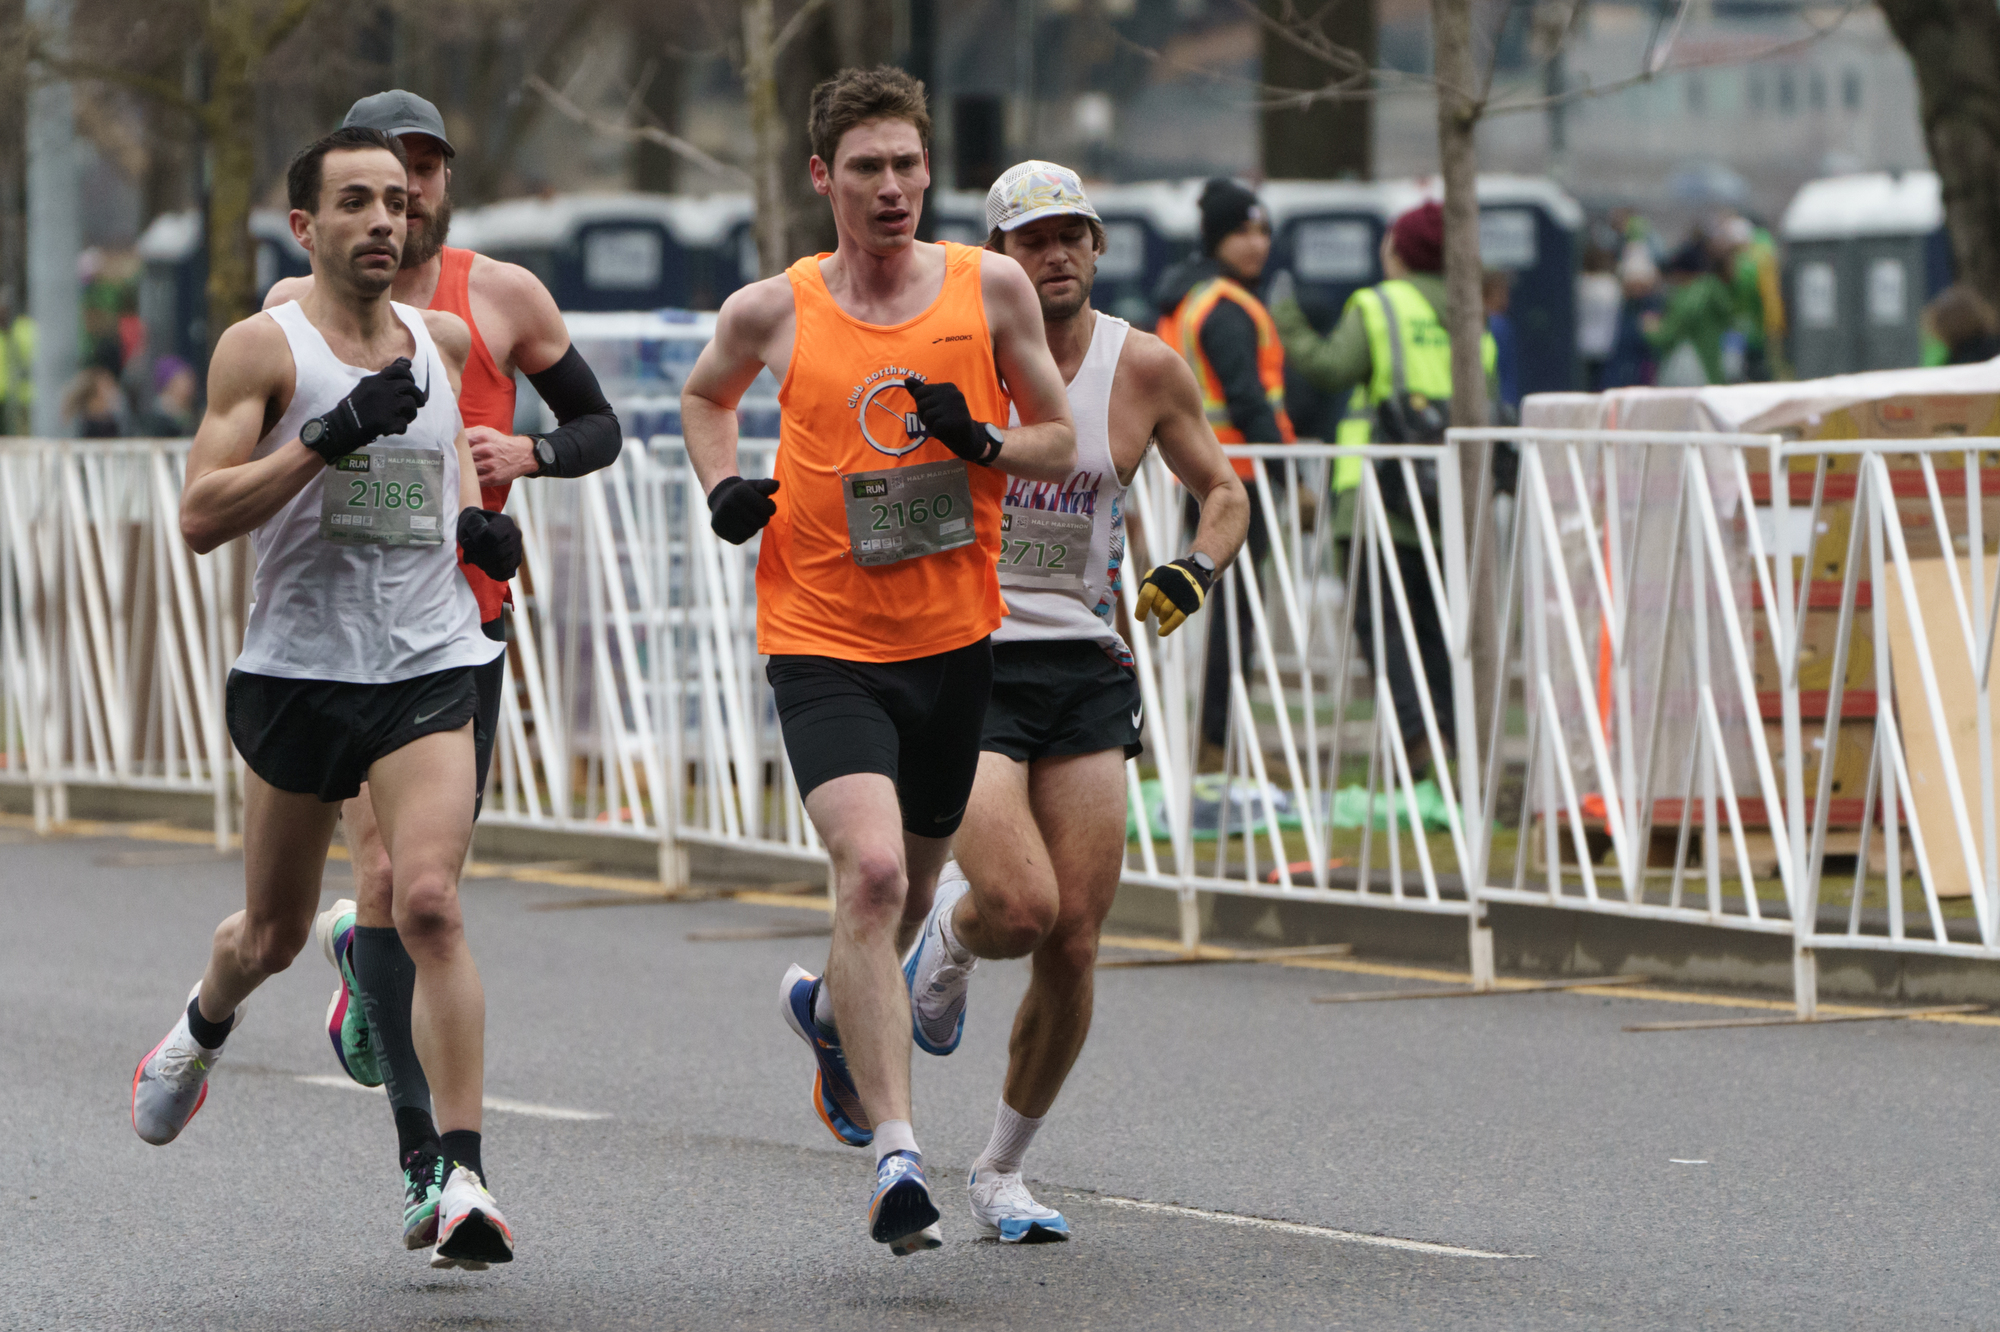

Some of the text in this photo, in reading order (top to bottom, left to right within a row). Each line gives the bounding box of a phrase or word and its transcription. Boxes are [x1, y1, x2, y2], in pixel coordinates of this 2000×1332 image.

[945, 334, 973, 343] BROOKS
[847, 365, 928, 409] club northwest
[349, 459, 368, 469] RUN
[405, 458, 440, 466] MARATHON
[907, 467, 965, 482] HALF MARATHON
[347, 479, 425, 511] 2186
[865, 484, 885, 494] RUN
[870, 493, 953, 532] 2160
[1051, 521, 1088, 530] MARATHON
[999, 538, 1067, 569] 2712
